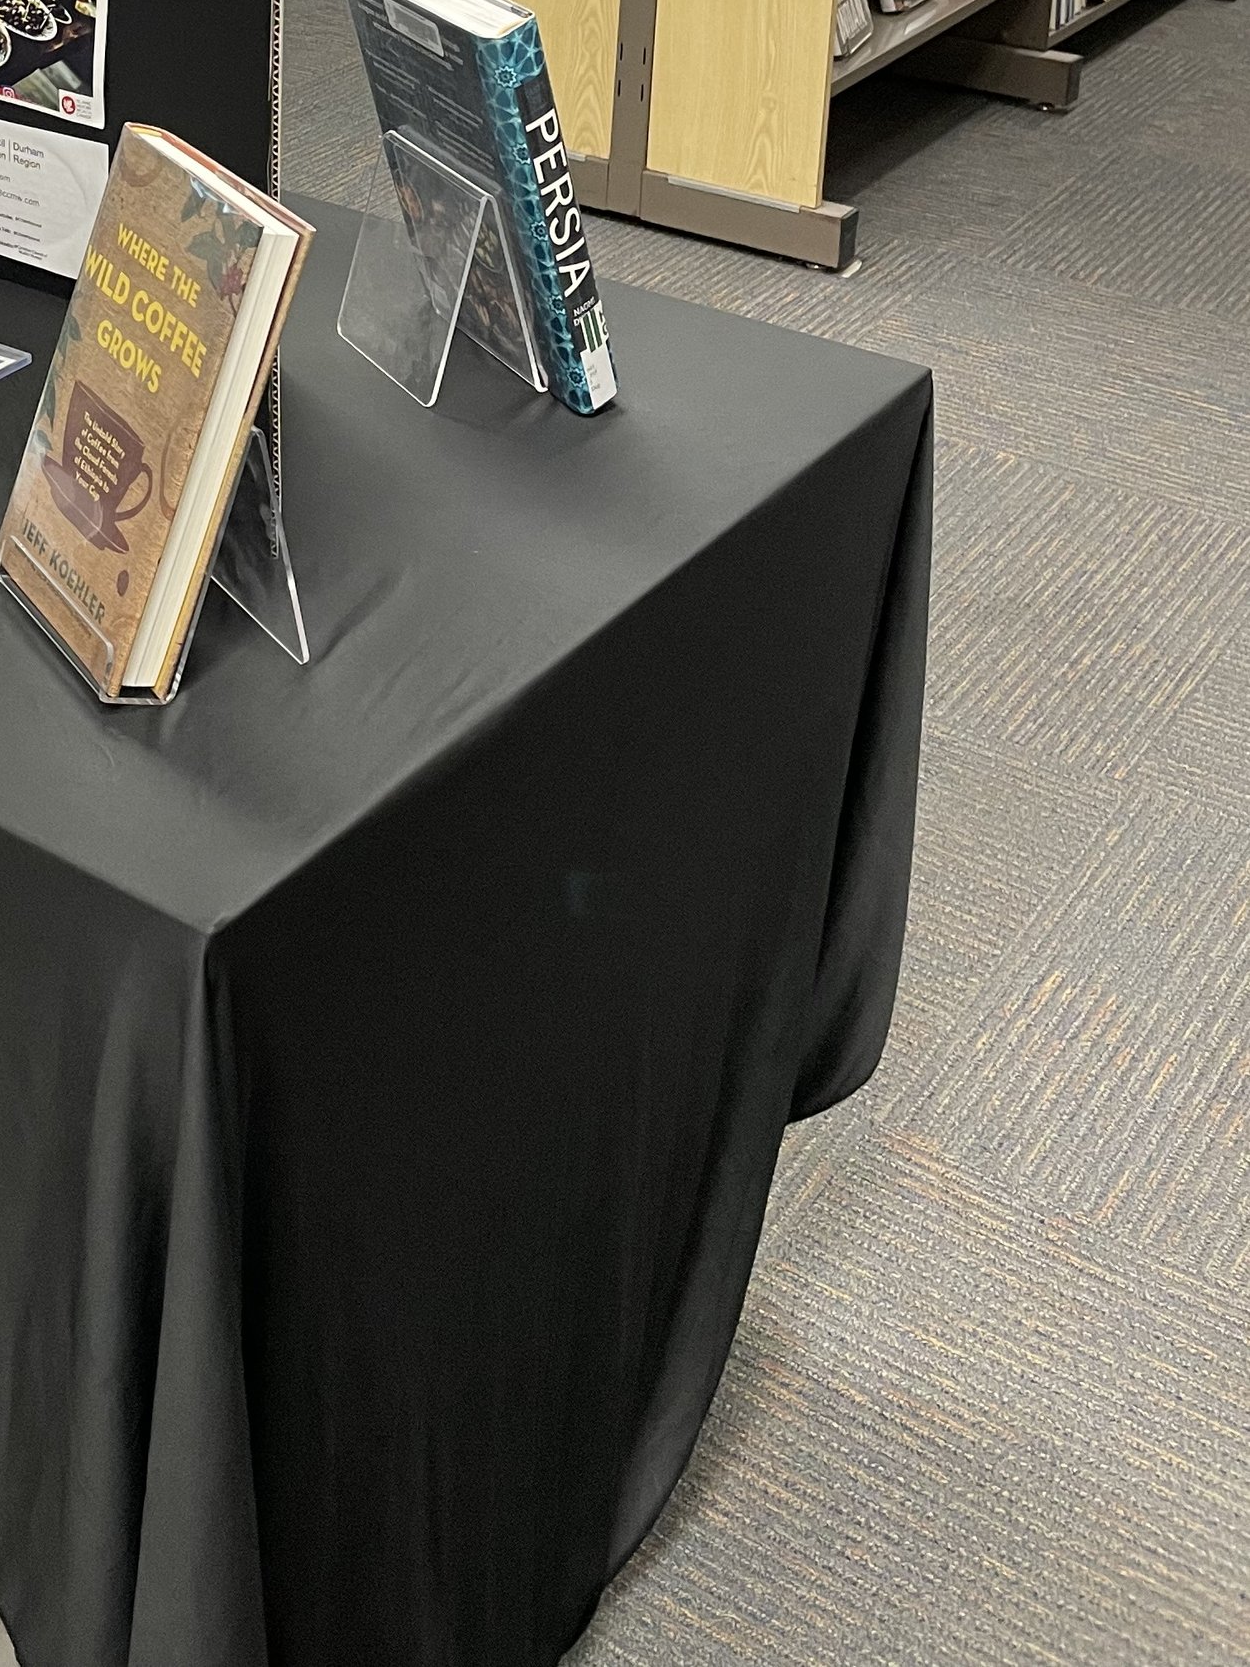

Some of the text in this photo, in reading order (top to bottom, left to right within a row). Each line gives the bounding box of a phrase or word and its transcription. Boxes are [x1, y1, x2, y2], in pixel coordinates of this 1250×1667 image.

[13, 141, 44, 158] Durham
[13, 154, 41, 170] Region
[525, 108, 591, 298] PERSIA
[117, 222, 201, 308] WHERE THE
[85, 244, 207, 379] WILD COFFEE
[96, 319, 162, 393] GROWS
[83, 446, 100, 466] Cloud
[87, 433, 106, 456] Coffee
[22, 519, 105, 624] JEFF KOEHLER
